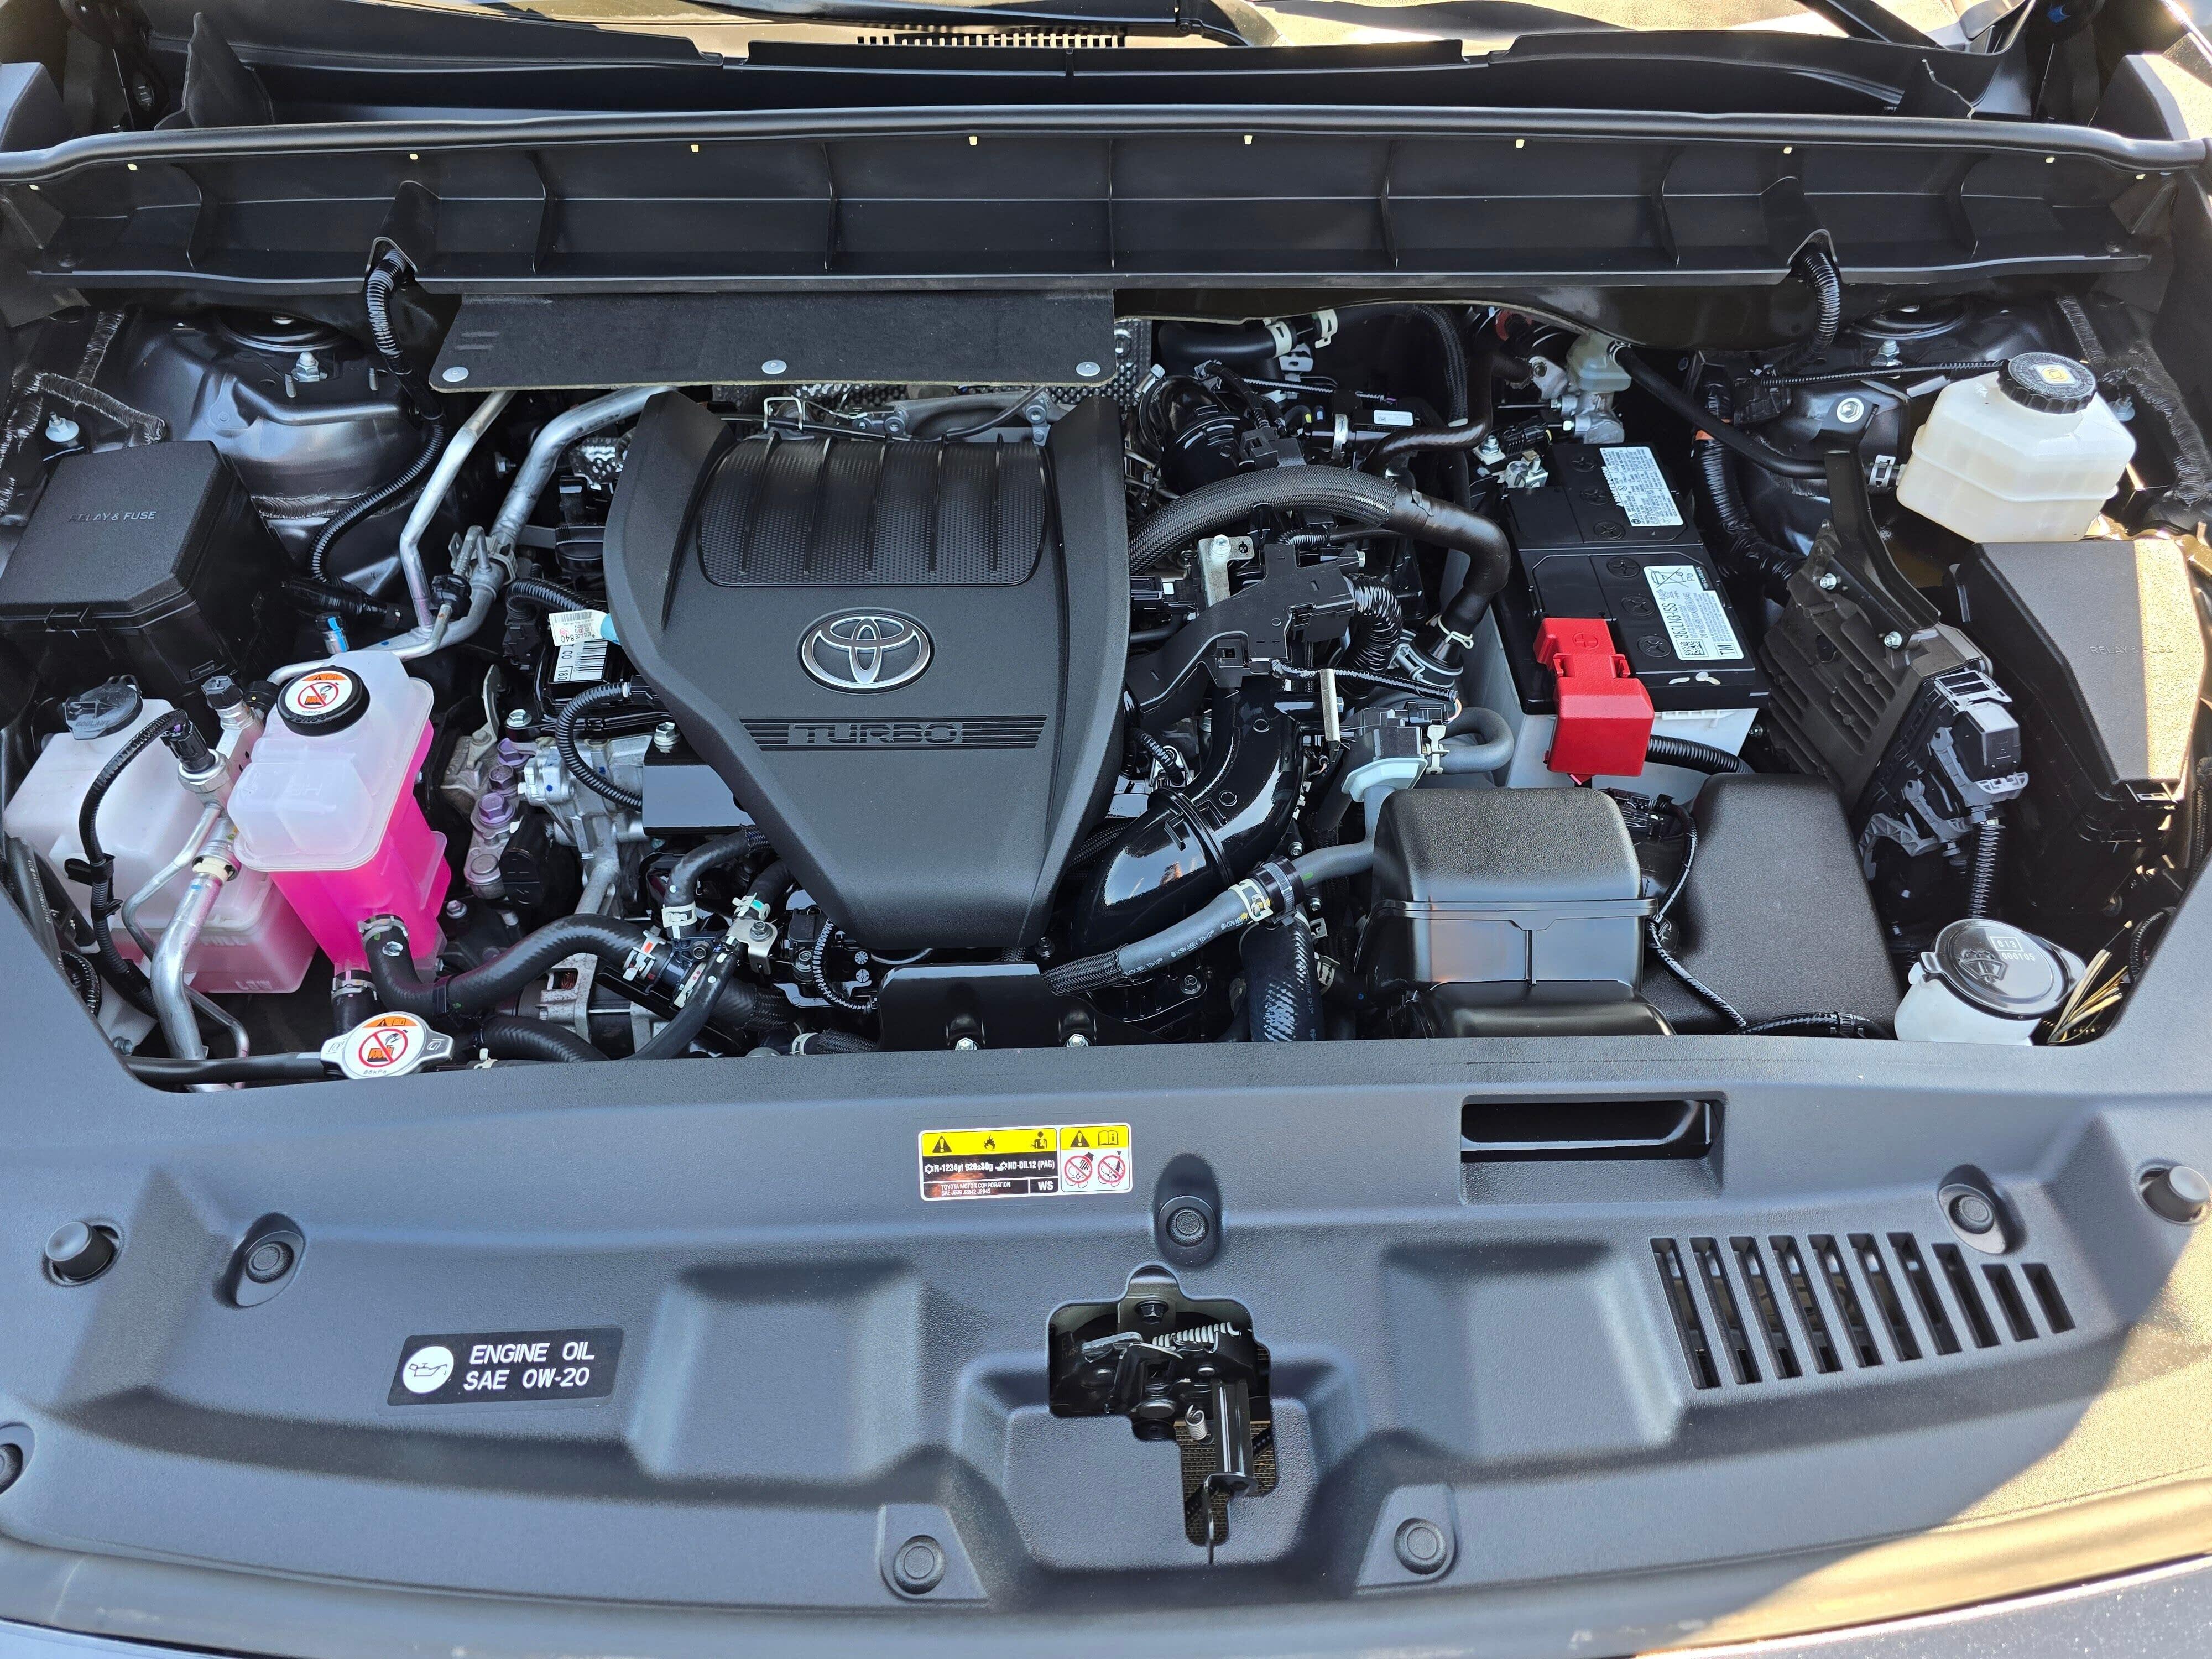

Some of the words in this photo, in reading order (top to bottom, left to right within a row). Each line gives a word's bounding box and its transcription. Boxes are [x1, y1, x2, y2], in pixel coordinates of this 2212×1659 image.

[111, 513, 119, 521] &
[124, 511, 157, 520] FUSE
[1718, 644, 1735, 655] TM
[2089, 646, 2127, 654] RELAY
[794, 722, 957, 744] TURBO
[234, 980, 273, 990] LOW
[1008, 1161, 1036, 1170] ND-OIL12
[1037, 1160, 1055, 1170] (PAG)
[1037, 1181, 1053, 1190] WS
[469, 1343, 551, 1365] ENGINE
[562, 1342, 595, 1360] OIL
[463, 1369, 510, 1391] SAE
[523, 1367, 590, 1388] 0W-20
